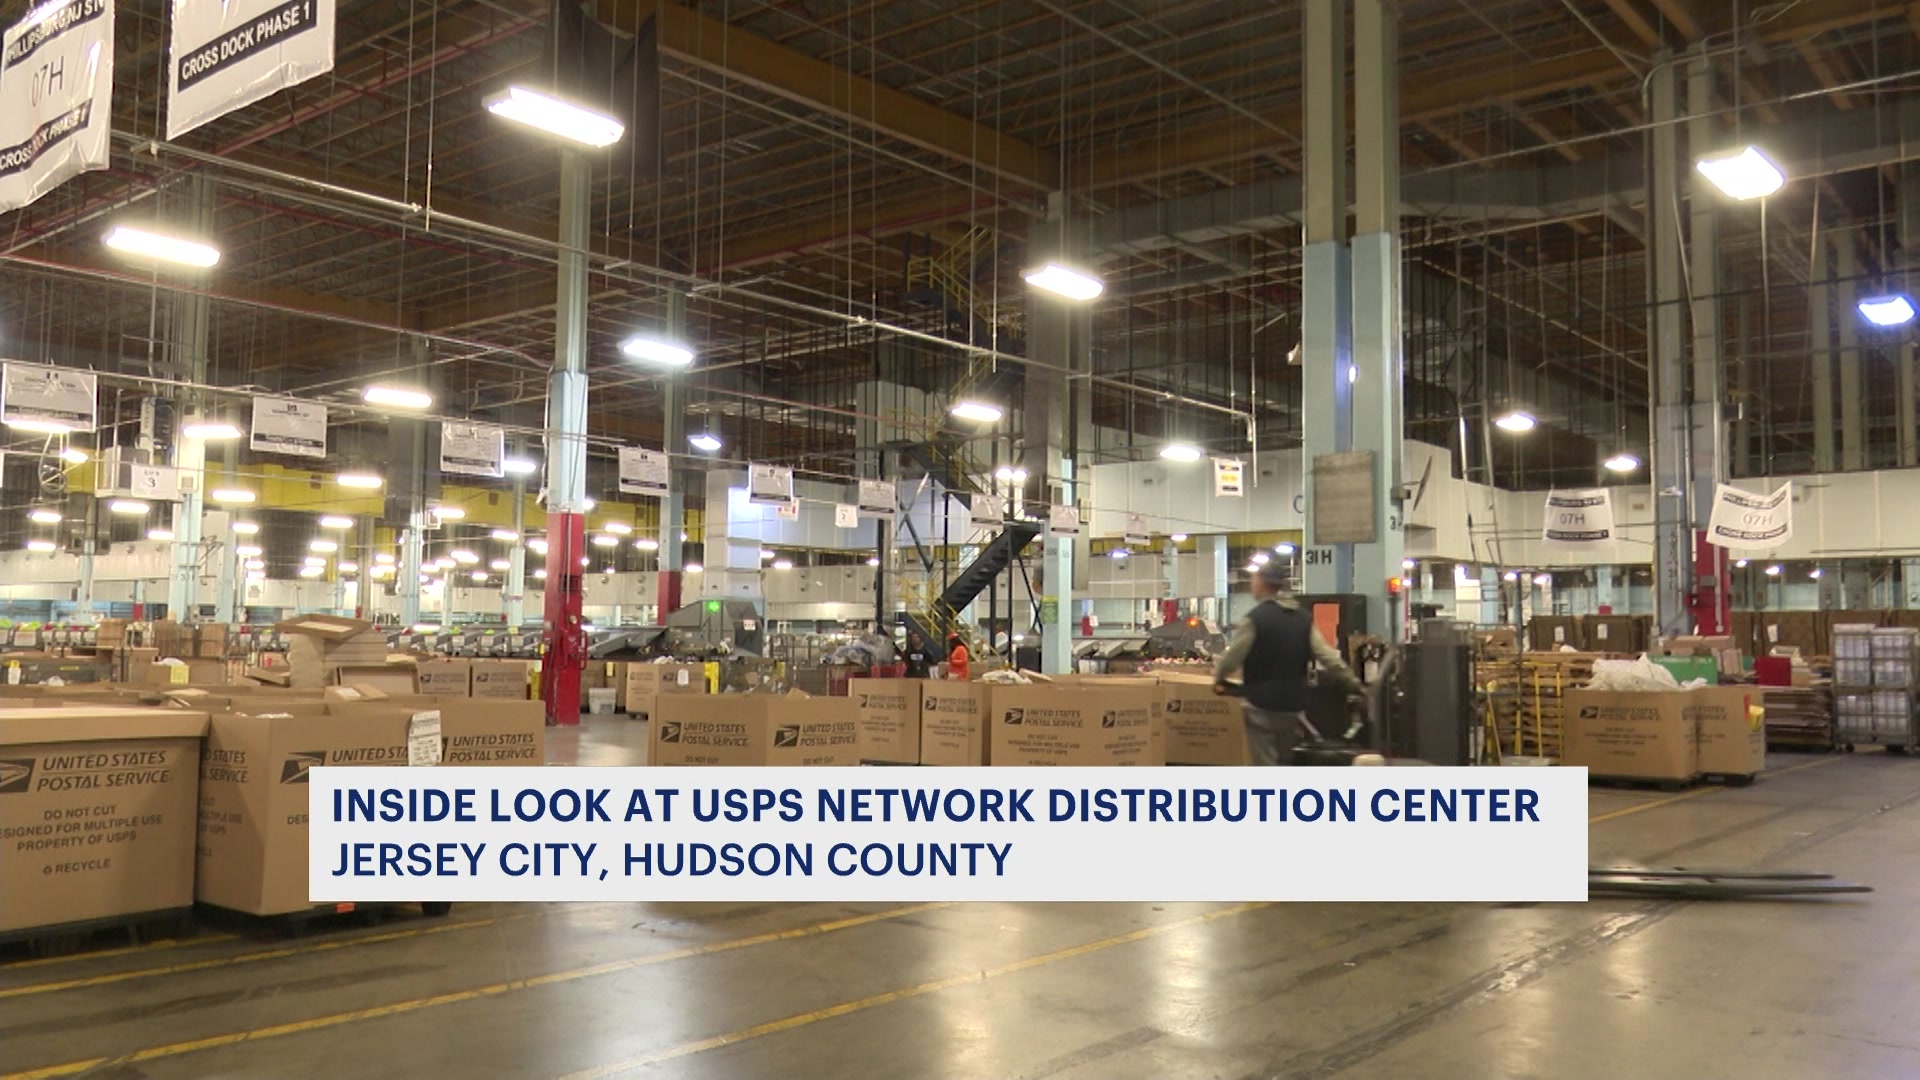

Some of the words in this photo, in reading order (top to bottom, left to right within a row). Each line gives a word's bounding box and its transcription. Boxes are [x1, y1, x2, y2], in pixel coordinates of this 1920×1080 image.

[68, 3, 83, 22] NJ
[182, 46, 219, 80] CROSS
[220, 27, 254, 60] DOCK
[256, 5, 300, 43] PHASE
[303, 1, 310, 20] 1
[32, 56, 64, 107] 07H
[0, 145, 32, 170] CROSS
[1560, 513, 1585, 525] 07H
[1743, 513, 1773, 526] 07H
[1026, 709, 1053, 717] UNITED
[684, 722, 714, 733] UNITED
[715, 723, 746, 734] STATES
[802, 723, 831, 733] UNITED
[832, 722, 856, 732] STATES
[452, 735, 500, 747] UNITED
[499, 733, 535, 745] STATES
[682, 736, 711, 746] POSTAL
[711, 737, 749, 747] SERVICE
[800, 737, 829, 746] POSTAL
[830, 735, 856, 744] SERVICE
[43, 754, 109, 771] UNITED
[111, 751, 167, 766] STATES
[211, 750, 246, 764] STATES
[332, 747, 385, 763] UNITED
[386, 746, 409, 760] STA
[450, 751, 493, 763] POSTAL
[494, 749, 536, 761] SERVICE
[36, 775, 103, 792] POSTAL
[105, 769, 172, 787] SERVICE
[209, 768, 249, 783] SERVICE
[44, 809, 62, 821] DO
[65, 807, 90, 819] NOT
[93, 805, 117, 815] CUT
[0, 825, 53, 839] SIGNED
[56, 822, 81, 834] FOR
[84, 817, 139, 831] MULTIPLE
[141, 815, 163, 825] USE
[17, 837, 85, 852] PROPERTY
[87, 834, 104, 845] OF
[106, 831, 137, 843] USPS
[55, 859, 112, 874] RECYCLE
